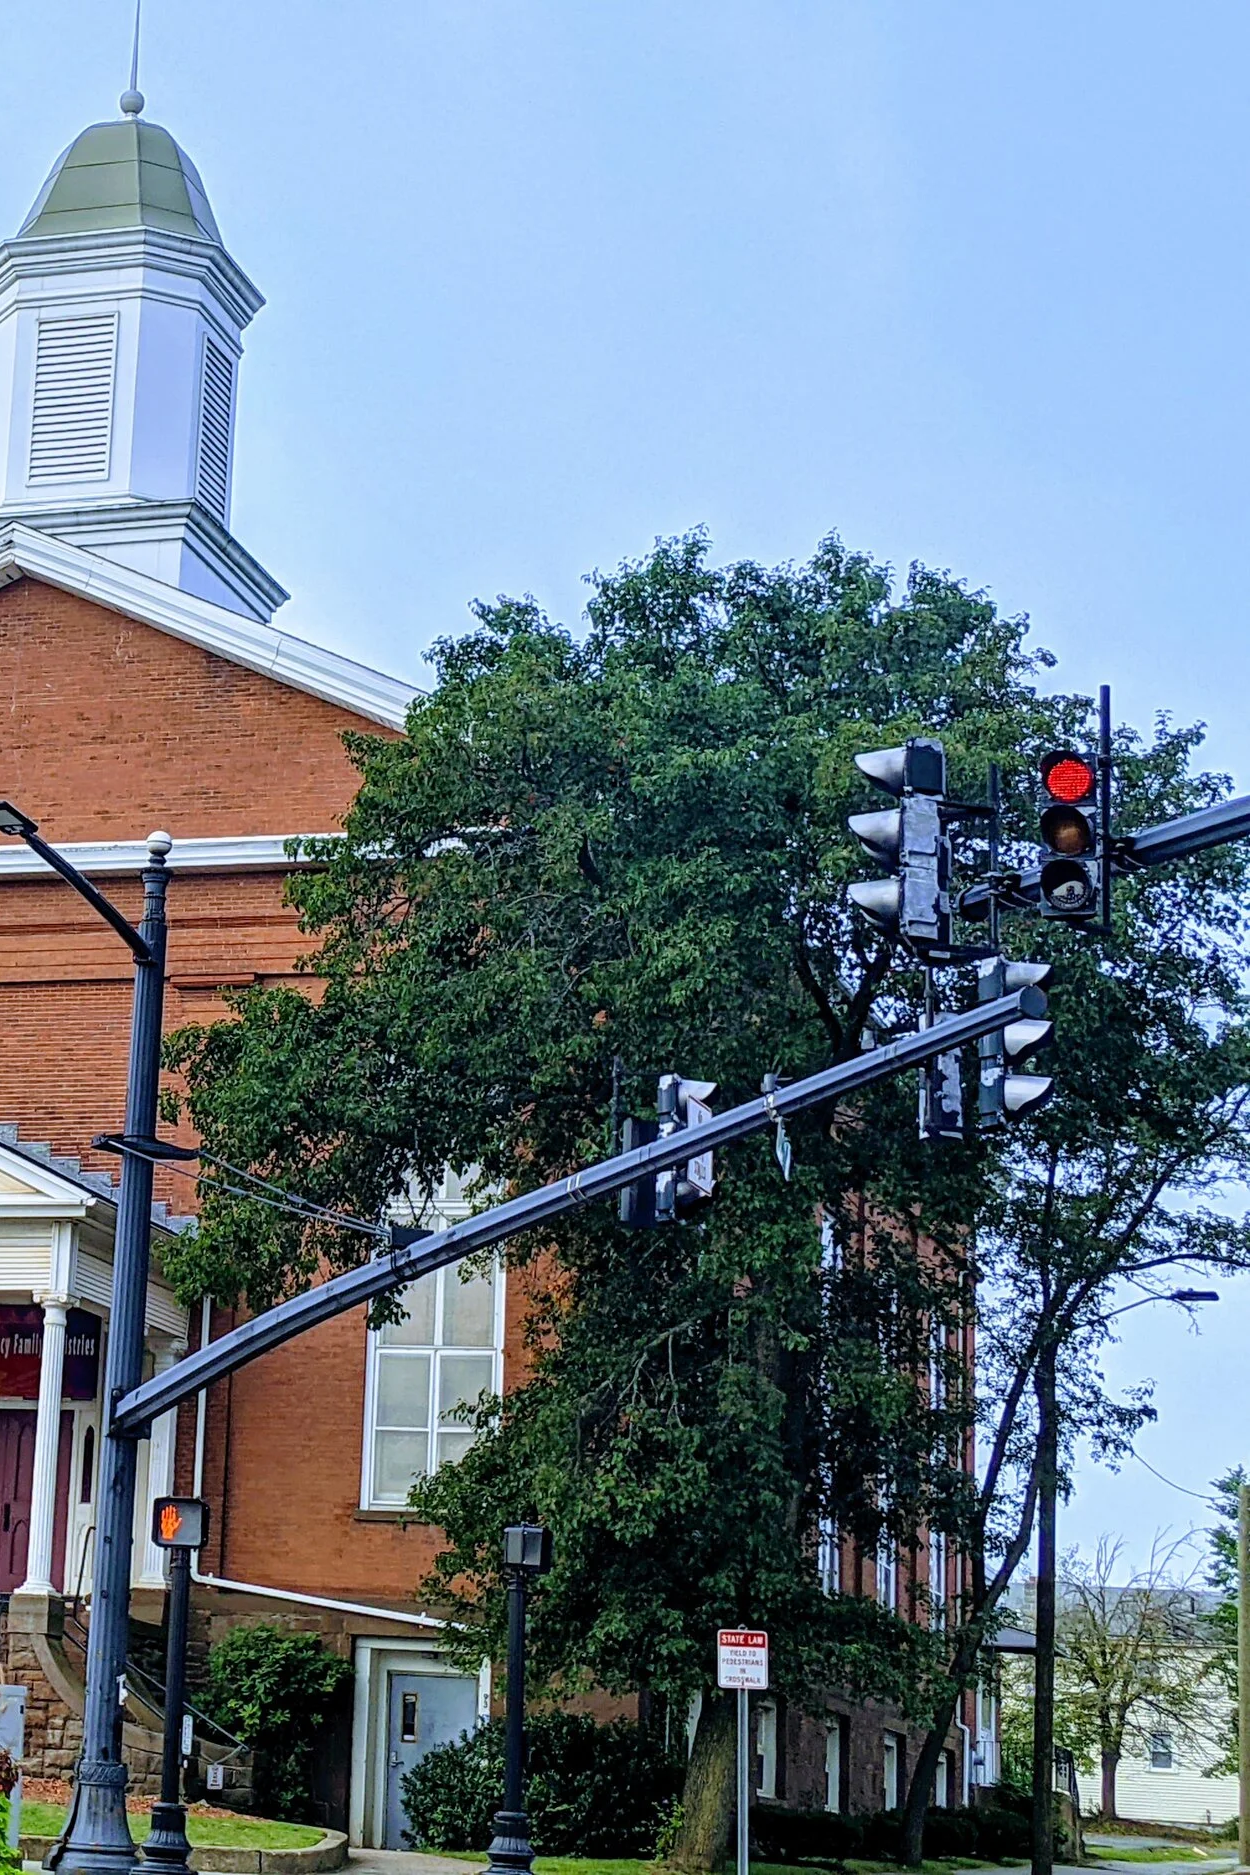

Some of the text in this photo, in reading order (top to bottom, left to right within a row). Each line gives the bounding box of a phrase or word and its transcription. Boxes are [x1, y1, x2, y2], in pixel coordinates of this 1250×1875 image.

[64, 1333, 95, 1357] istries
[721, 1634, 763, 1645] STATE LAW
[722, 1658, 763, 1666] PEDESTRIANS
